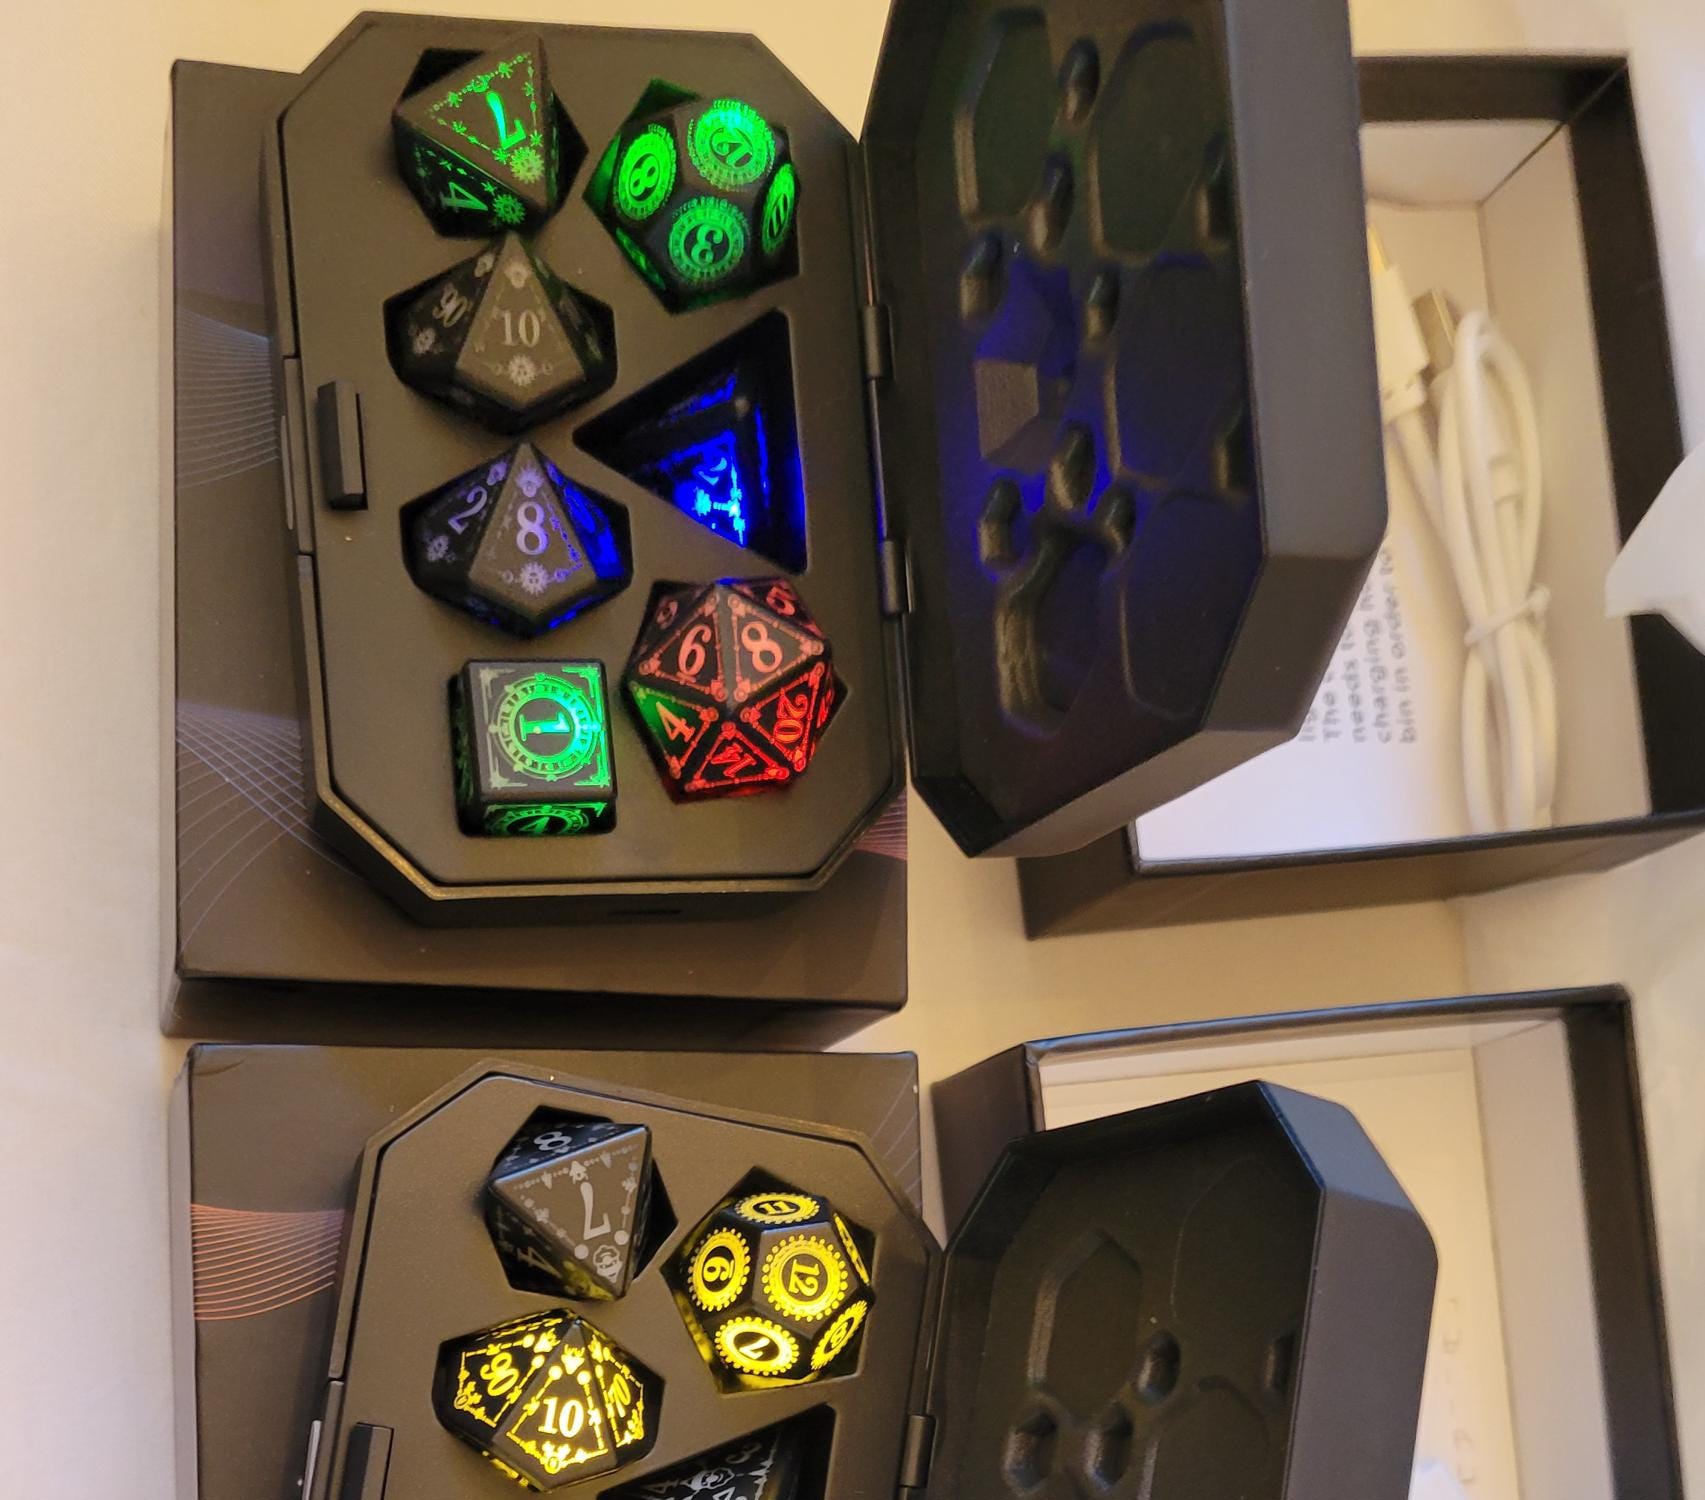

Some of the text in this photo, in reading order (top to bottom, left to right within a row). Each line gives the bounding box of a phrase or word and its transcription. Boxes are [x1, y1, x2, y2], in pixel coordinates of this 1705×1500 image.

[486, 90, 527, 150] 7
[440, 182, 489, 212] 4
[630, 156, 660, 197] 8
[502, 310, 541, 348] 10
[449, 485, 488, 535] 2
[516, 501, 550, 555] 8
[676, 624, 712, 683] 6
[741, 621, 783, 673] 8
[1362, 620, 1392, 744] charging
[519, 712, 570, 741] 1
[656, 701, 695, 742] 4
[774, 690, 808, 743] 20
[1322, 693, 1344, 744] The
[534, 1131, 571, 1152] 8
[580, 1182, 611, 1240] 7
[758, 1200, 796, 1216] 11
[788, 1259, 820, 1297] 12
[538, 1396, 584, 1438] 10
